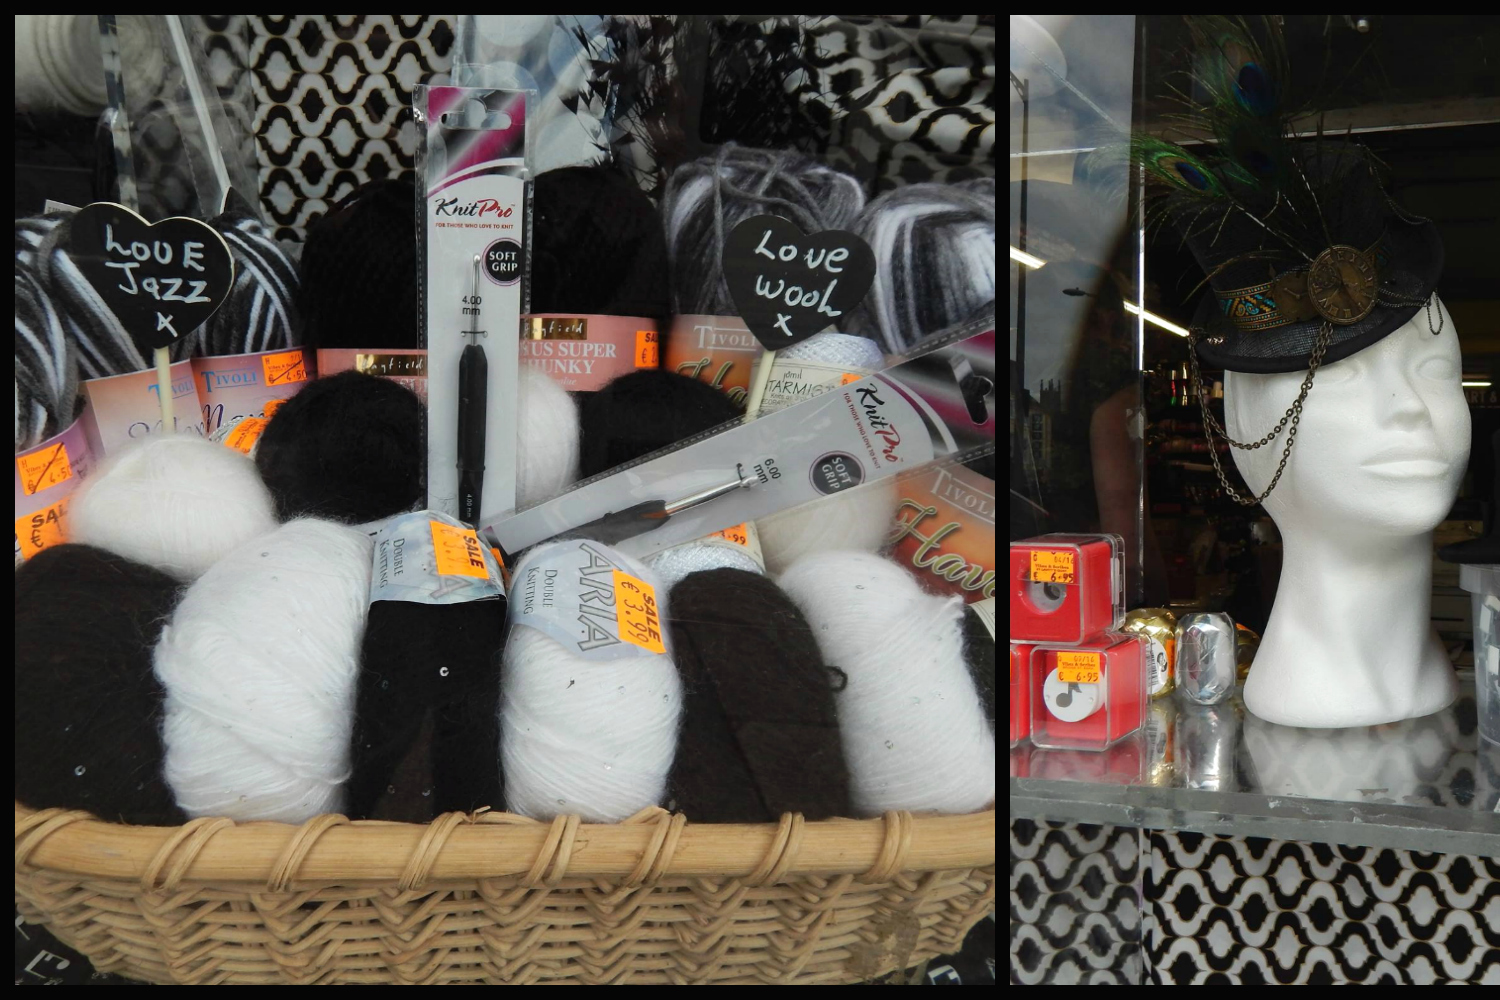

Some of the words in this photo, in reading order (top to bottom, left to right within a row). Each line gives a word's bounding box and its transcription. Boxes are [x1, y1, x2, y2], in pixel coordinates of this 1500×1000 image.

[435, 197, 514, 218] KnitPro
[489, 250, 517, 261] SOFT
[754, 229, 850, 273] Love
[491, 262, 518, 272] GRIP
[462, 295, 482, 305] 4.00
[462, 307, 481, 316] mm
[558, 342, 616, 358] SUPER
[527, 358, 595, 374] HUNKY
[201, 369, 258, 393] TIVOLI
[856, 383, 901, 463] KnitPro
[753, 464, 769, 484] mm
[764, 458, 782, 480] 6.00
[822, 464, 840, 489] GRIP
[832, 457, 852, 483] SOFT
[380, 539, 390, 589] KNITTING
[392, 538, 405, 577] DOUBLE
[463, 535, 485, 570] SALE
[523, 566, 540, 615] KNITTING
[542, 569, 558, 608] DOUBLE
[577, 543, 623, 652] ARIA
[623, 598, 649, 643] 3.99
[643, 592, 661, 644] SALE
[1076, 672, 1098, 682] 6.95
